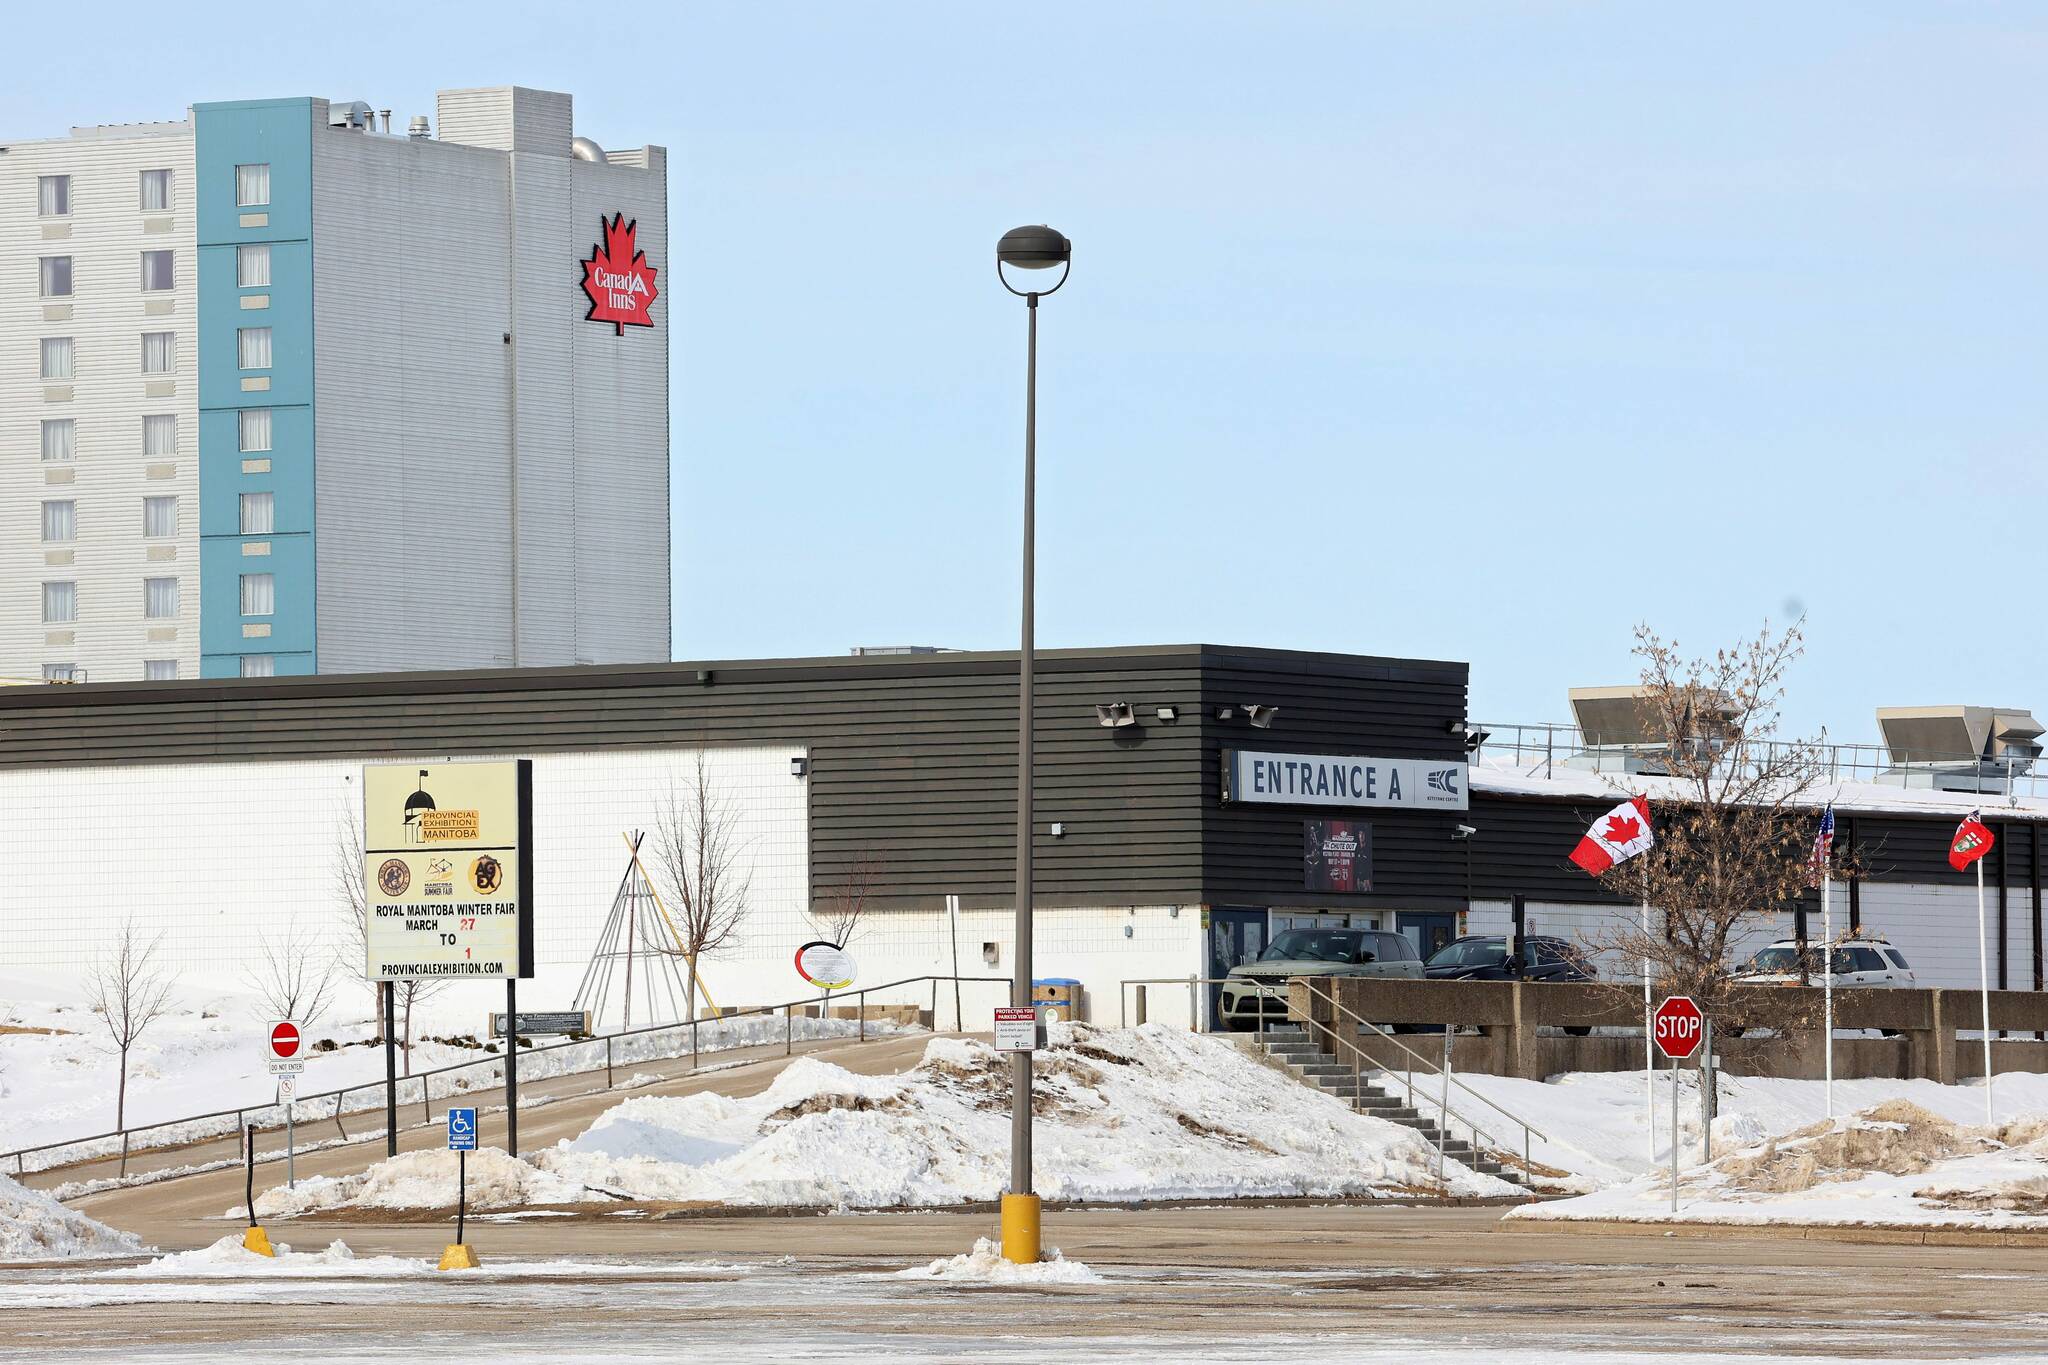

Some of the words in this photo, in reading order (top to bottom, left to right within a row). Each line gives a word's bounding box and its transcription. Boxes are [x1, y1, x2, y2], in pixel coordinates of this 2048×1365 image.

[608, 288, 636, 311] Inns
[1253, 760, 1377, 799] ENTRANCE
[1389, 768, 1401, 800] A
[423, 819, 472, 827] EXHIBITION
[423, 829, 477, 838] MANITOBA
[424, 887, 442, 896] SUMMER
[442, 887, 453, 896] FAIR
[376, 906, 405, 917] ROYAL
[407, 904, 454, 917] MANITOBA
[457, 903, 492, 916] WINTER
[495, 902, 515, 915] FAIR
[406, 919, 438, 931] MARCH
[460, 918, 476, 931] 27
[440, 933, 457, 946] TO
[465, 947, 471, 959] 1
[381, 962, 503, 976] PROVINCIALEXHIBITION.COM
[1657, 1015, 1700, 1039] STOP
